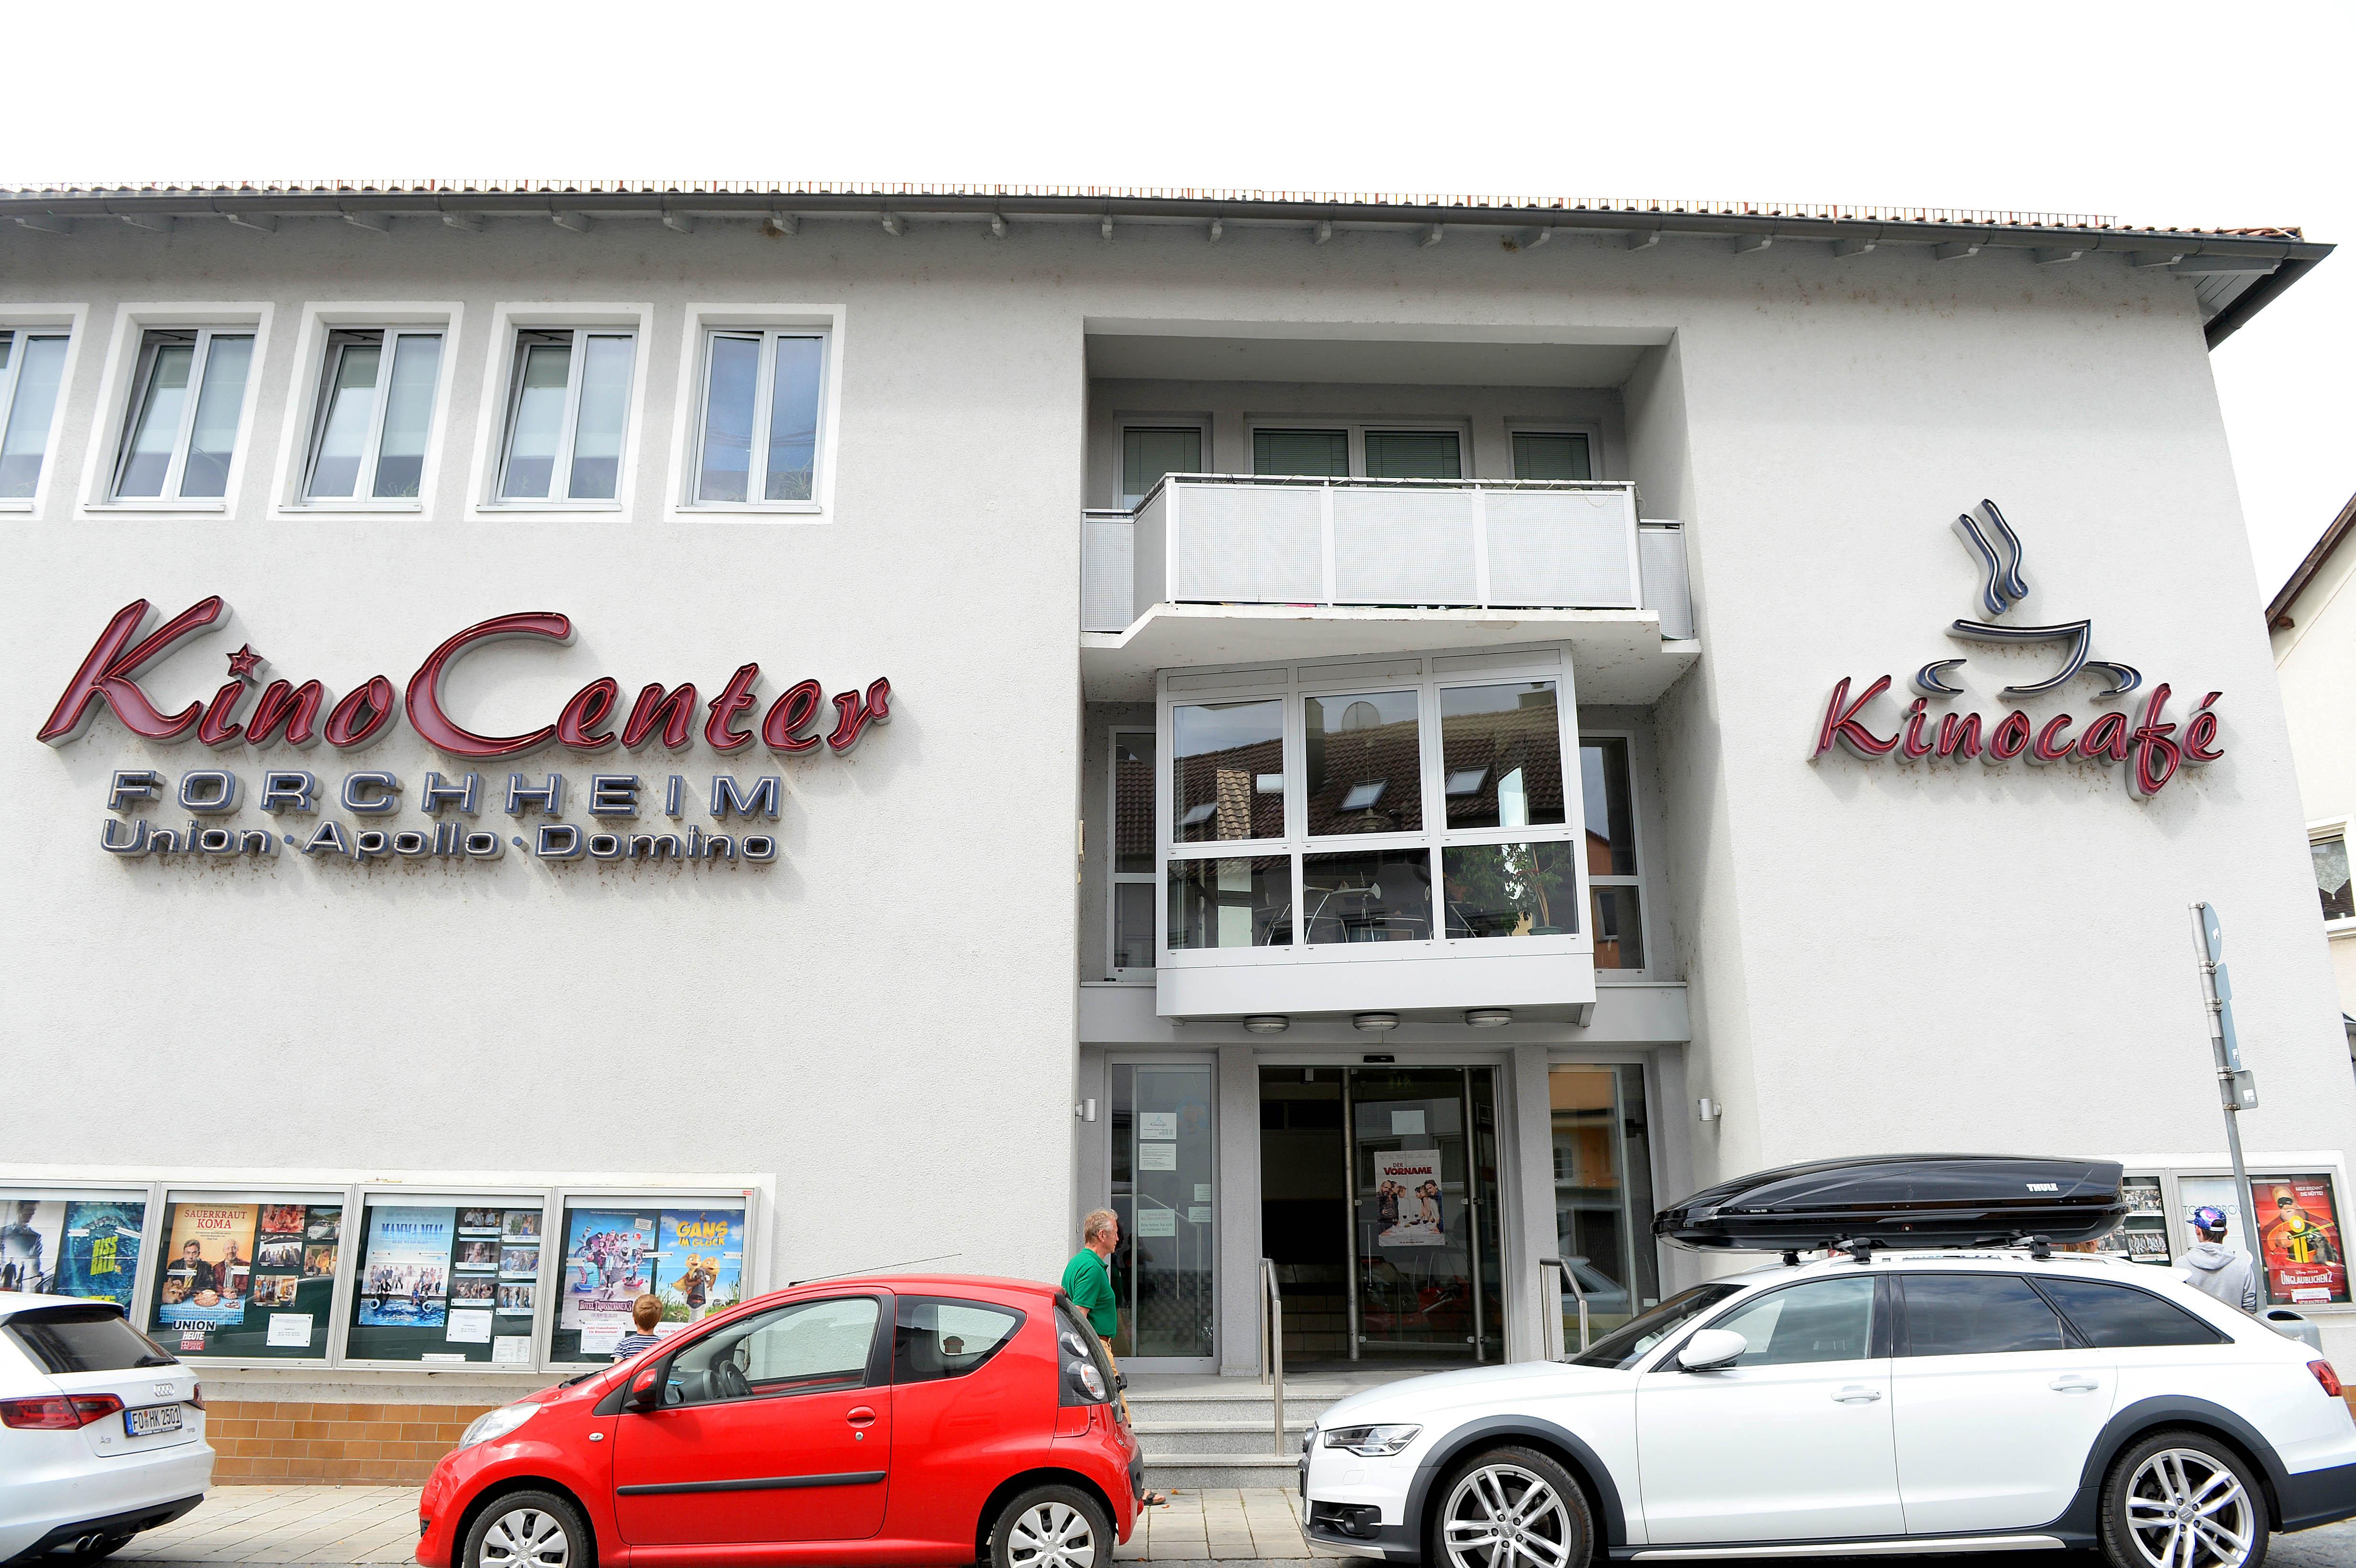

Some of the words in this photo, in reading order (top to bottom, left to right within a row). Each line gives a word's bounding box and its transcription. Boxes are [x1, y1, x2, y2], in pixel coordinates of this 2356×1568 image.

[1812, 675, 2225, 797] Kinocafé
[107, 770, 783, 821] FORCHHEIM
[1383, 1167, 1432, 1175] VORNAME
[2026, 1183, 2059, 1192] THULE
[185, 1209, 247, 1219] SAUERKRAUT
[197, 1219, 231, 1229] KOMA
[676, 1220, 729, 1238] GANS
[380, 1223, 418, 1239] MAMMA
[679, 1237, 690, 1246] IM
[173, 1320, 215, 1330] UNION
[182, 1331, 205, 1340] HEUTE
[132, 1412, 144, 1430] FO
[149, 1410, 160, 1428] HK
[161, 1407, 180, 1426] 2501
[99, 1436, 111, 1445] A3
